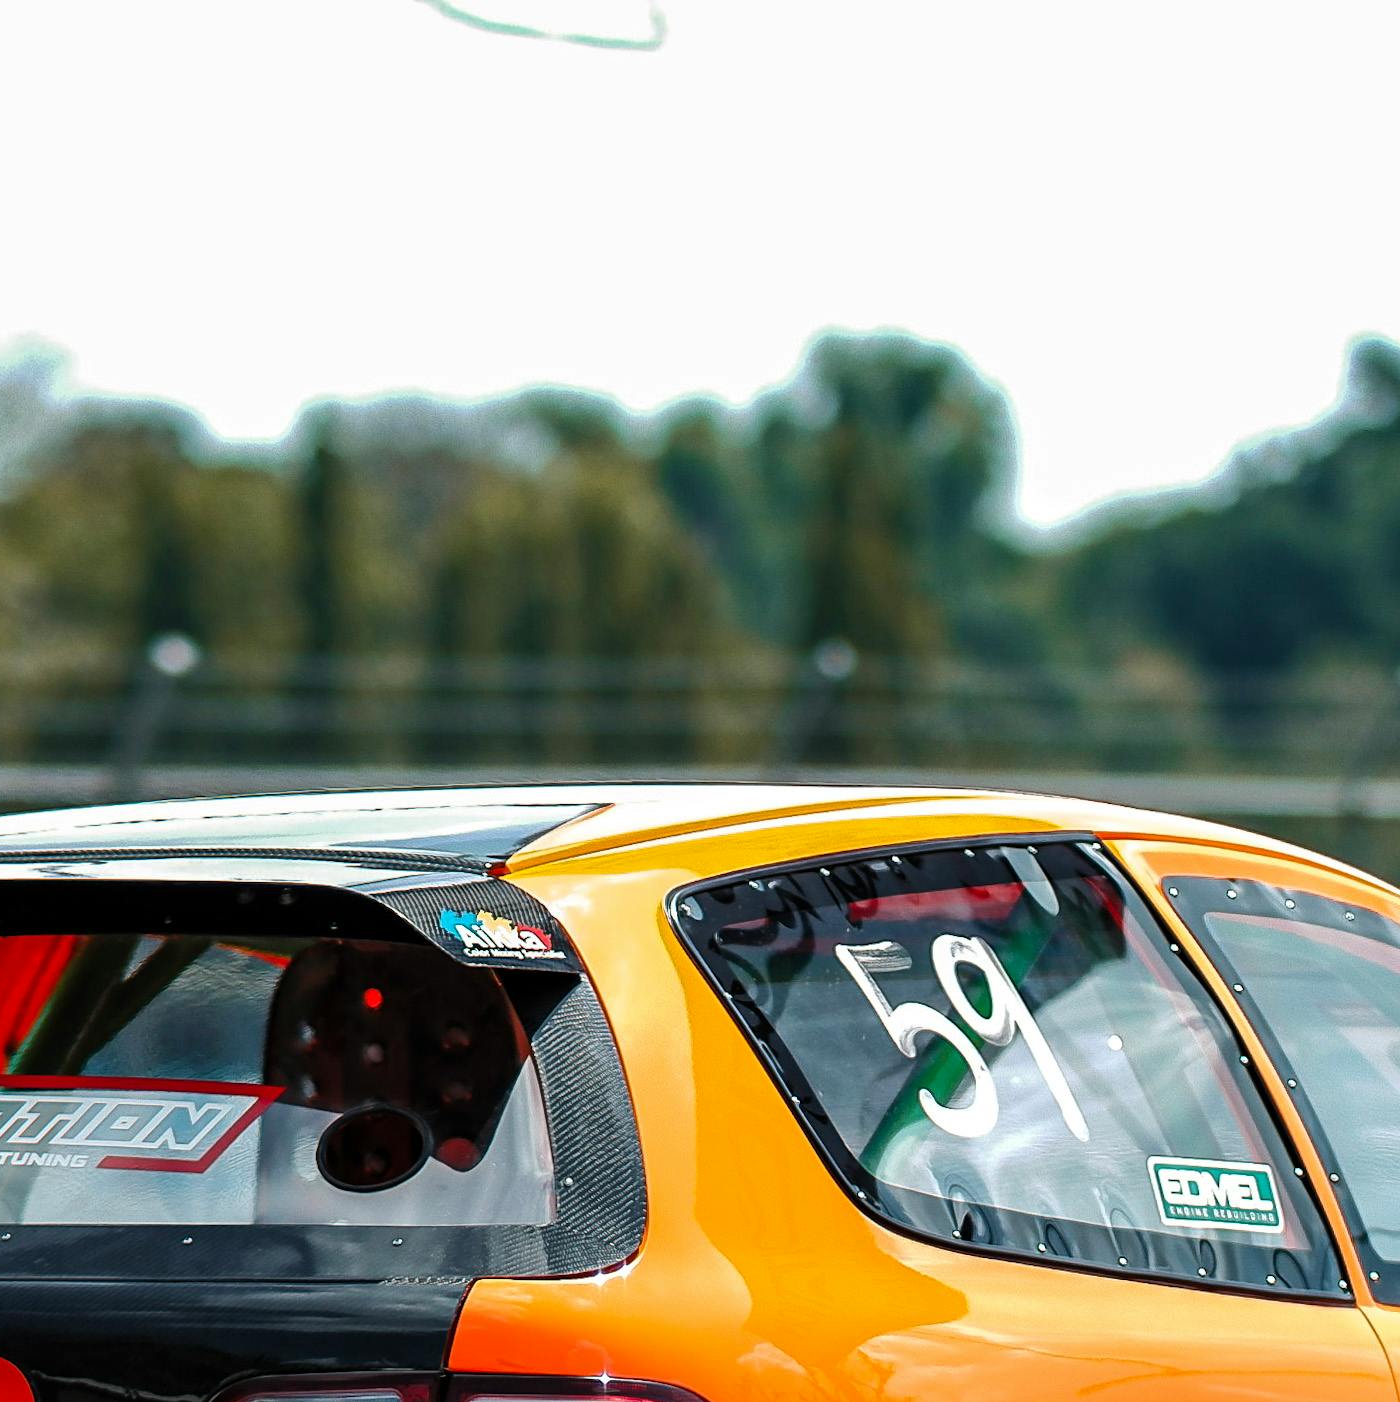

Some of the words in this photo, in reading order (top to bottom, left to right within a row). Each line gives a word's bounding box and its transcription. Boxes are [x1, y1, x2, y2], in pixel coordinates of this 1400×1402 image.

[834, 933, 1090, 1142] 59
[1158, 1168, 1273, 1210] EDMEL
[1168, 1205, 1209, 1217] ENGINE
[1213, 1208, 1275, 1222] REBUILDING
